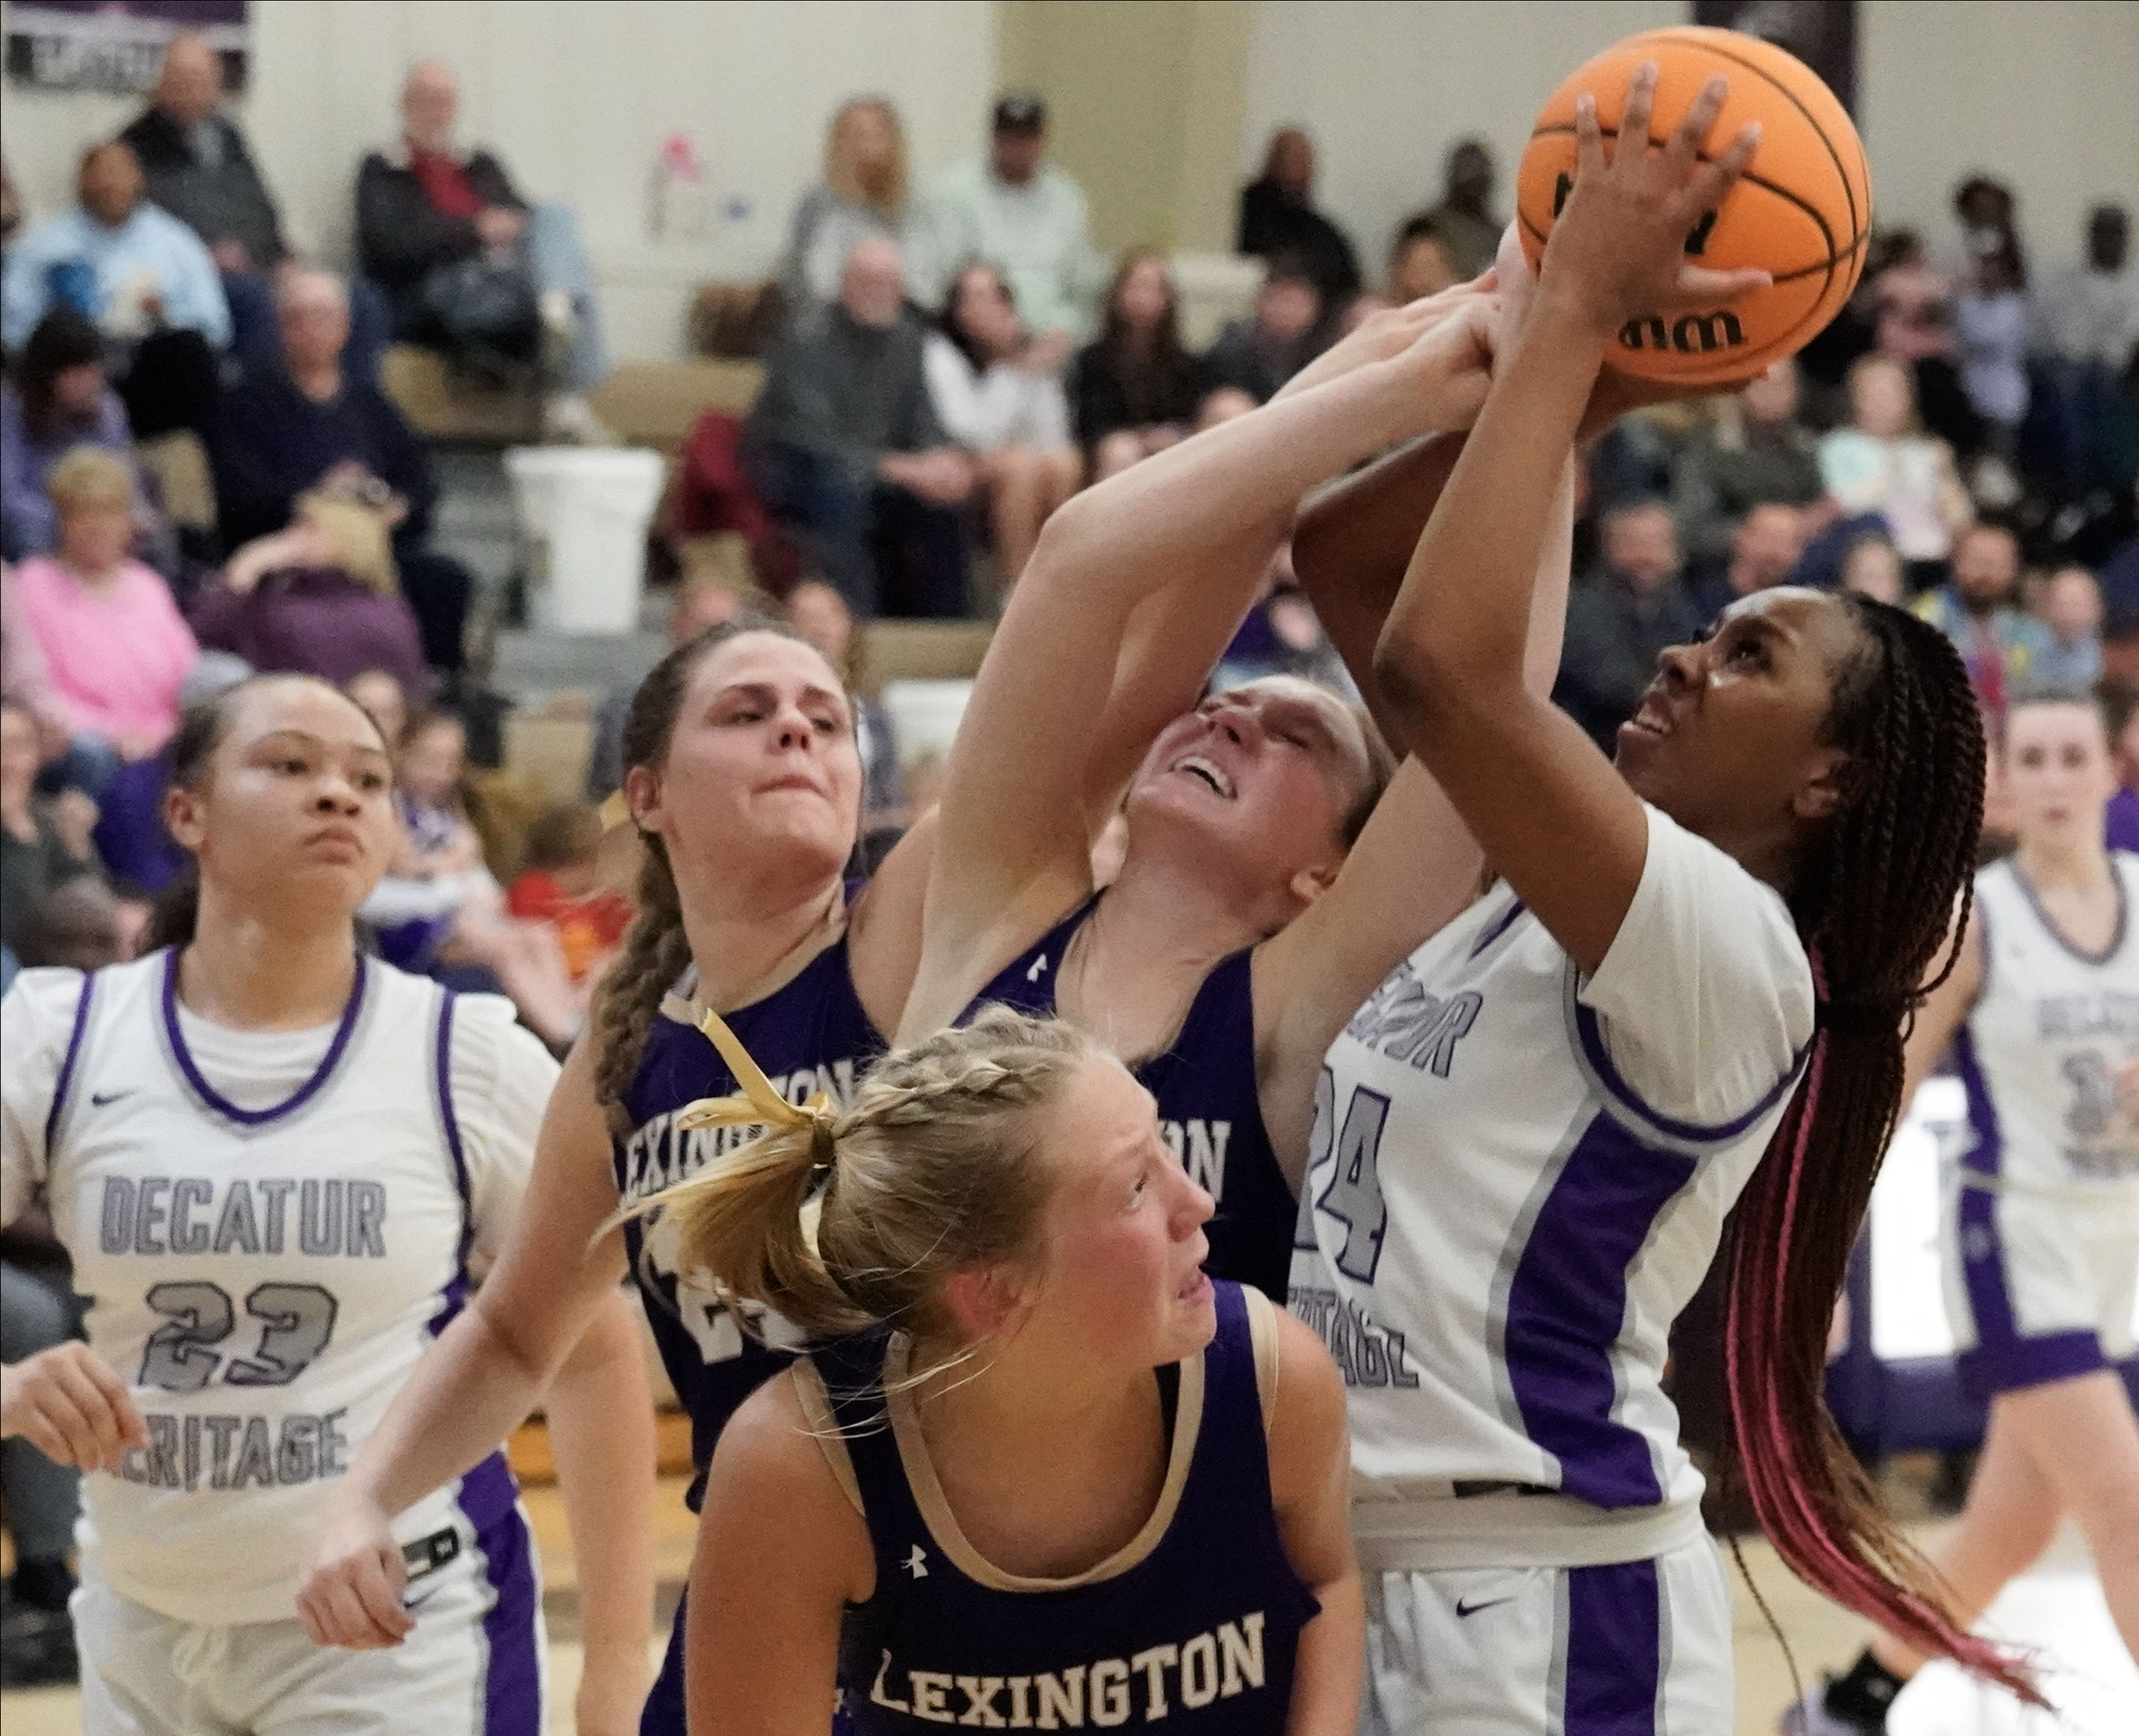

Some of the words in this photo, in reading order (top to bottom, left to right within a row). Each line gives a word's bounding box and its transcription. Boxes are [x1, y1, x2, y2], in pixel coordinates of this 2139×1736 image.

[99, 1174, 388, 1258] DECATUR
[138, 1280, 339, 1394] 23
[869, 1610, 1266, 1730] LEXINGTON
